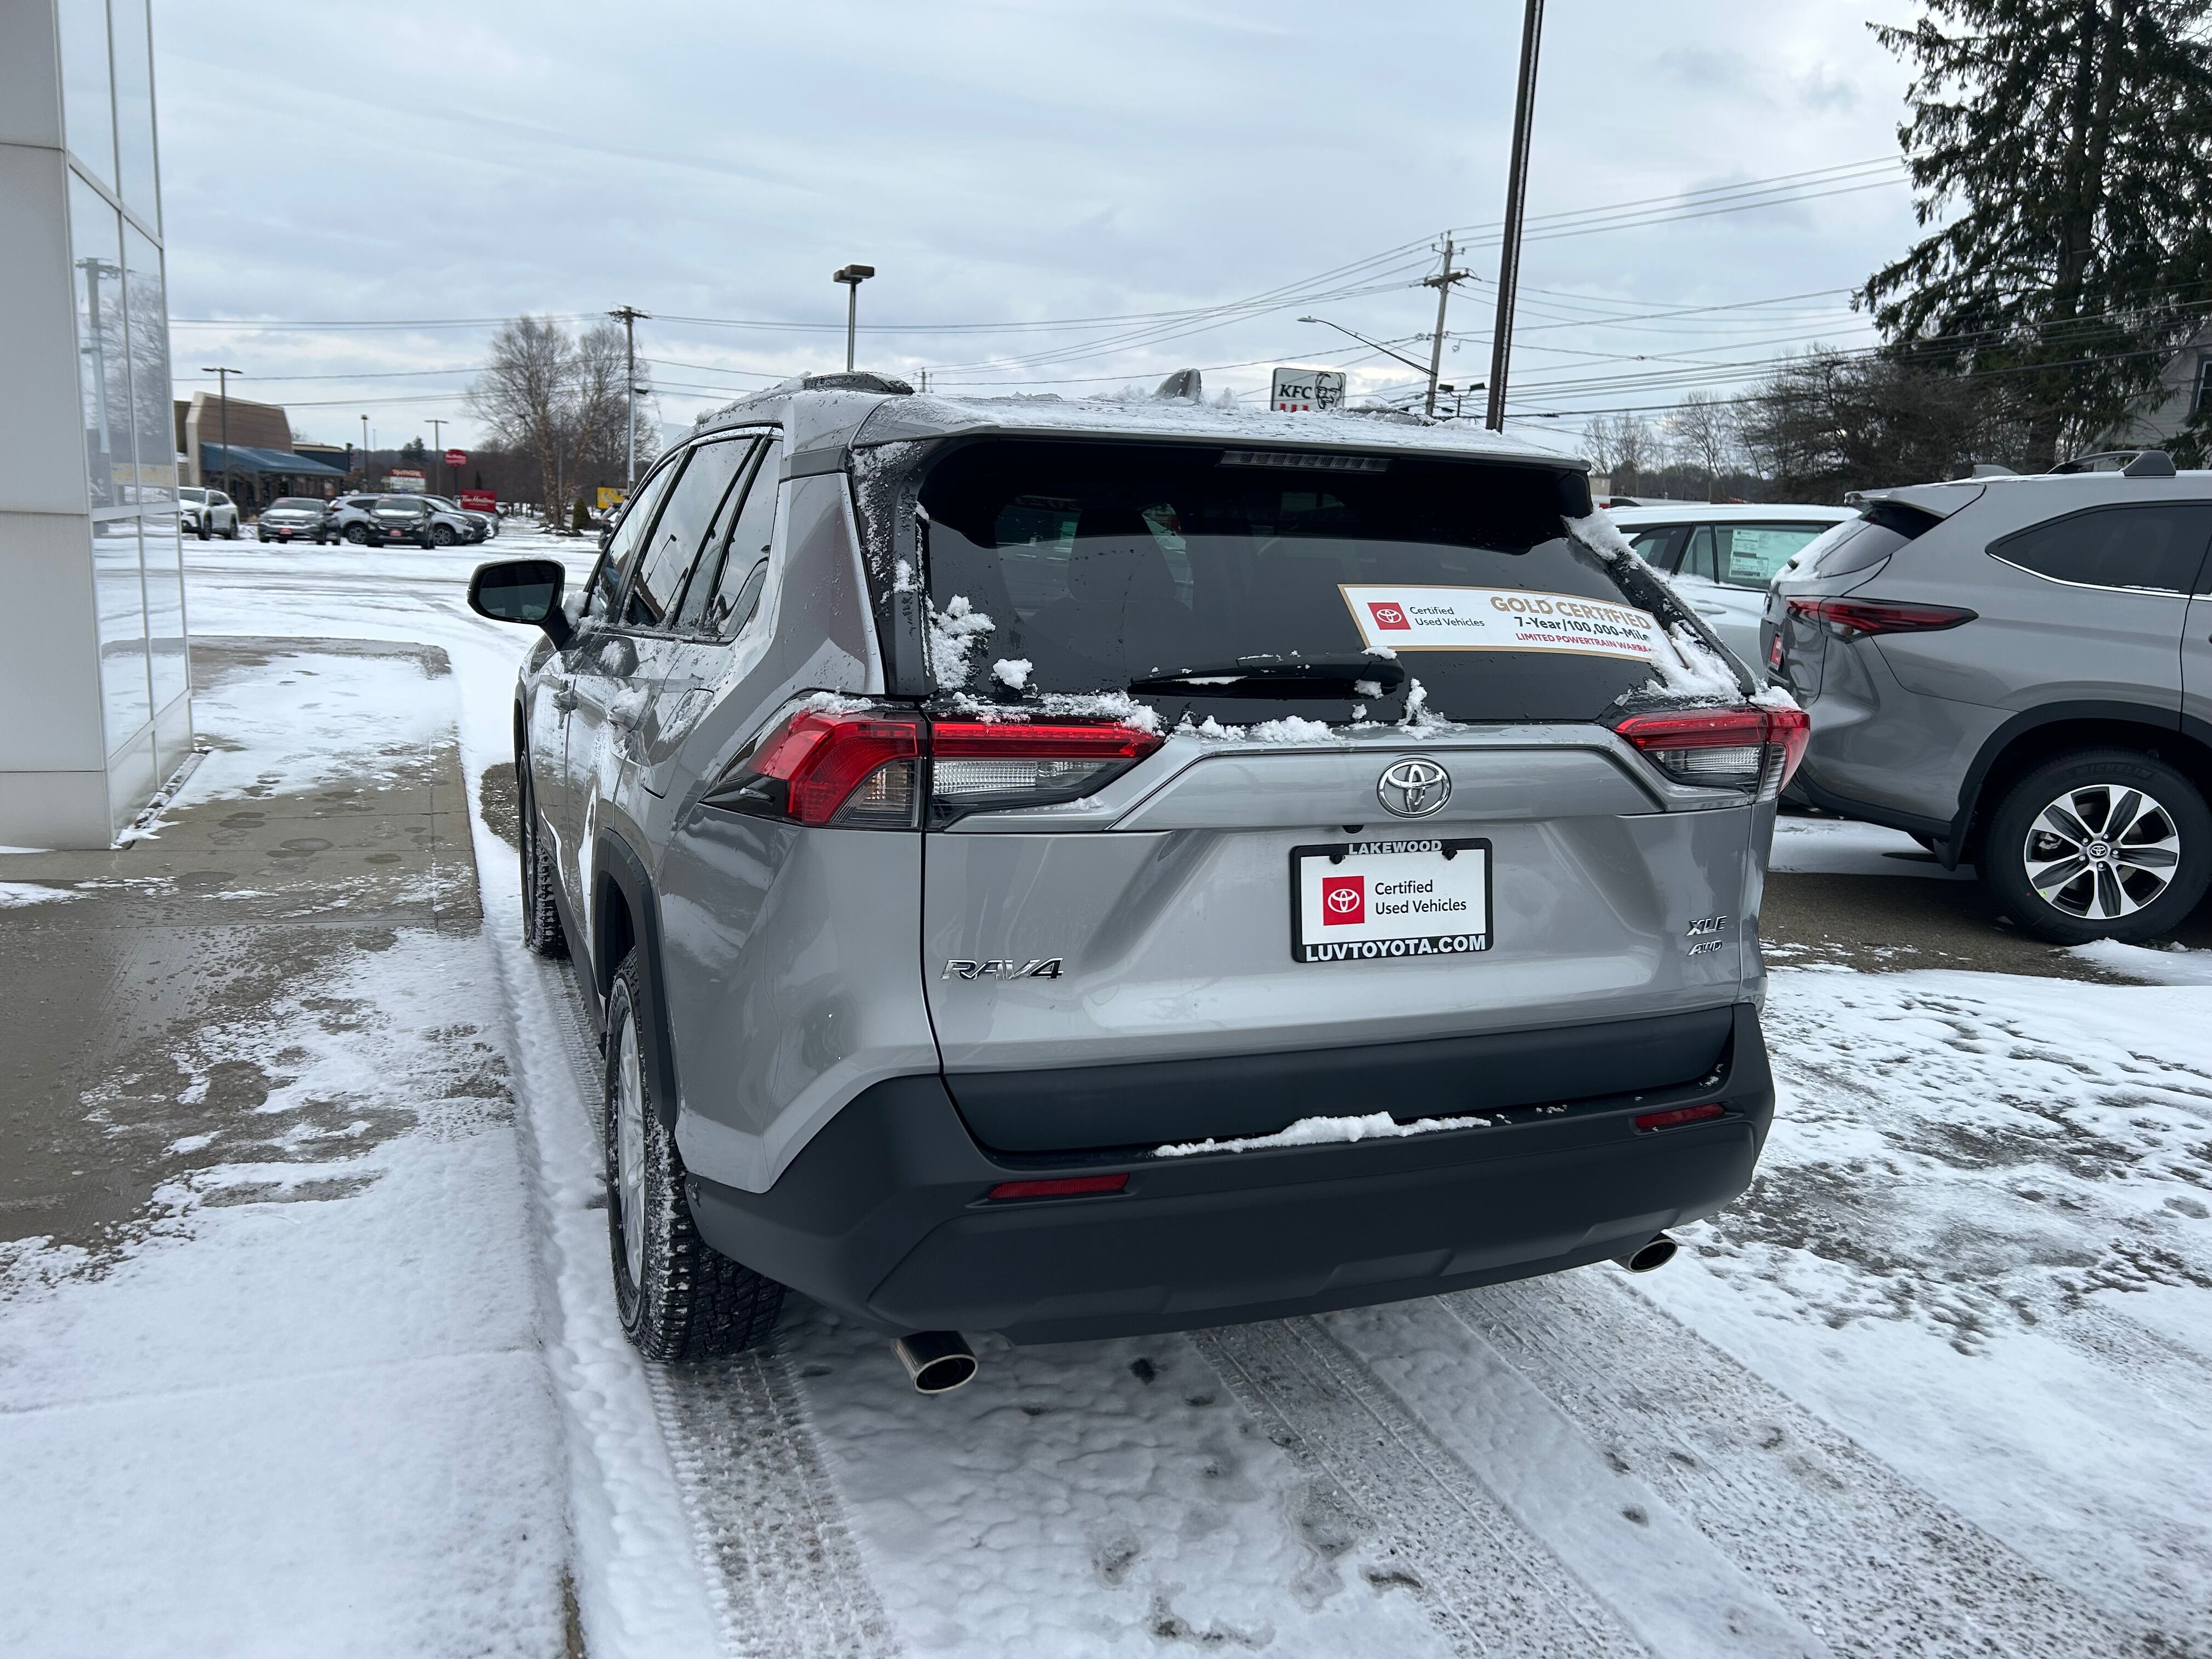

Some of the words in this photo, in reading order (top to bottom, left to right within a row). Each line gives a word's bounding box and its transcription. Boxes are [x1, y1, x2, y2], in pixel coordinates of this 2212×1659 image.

[1278, 383, 1312, 399] KFC
[1409, 606, 1455, 615] Certified
[1491, 597, 1553, 614] GOLD
[1556, 602, 1651, 629] CERTIFIED
[1414, 618, 1442, 626] Used
[1442, 618, 1485, 627] Vehicles
[1515, 633, 1555, 642] LIMITED
[1555, 635, 1617, 648] POWERTRAIN
[1616, 641, 1651, 652] WARRA
[1348, 840, 1442, 855] LAKEWOOD
[1375, 879, 1433, 895] Certified
[1375, 900, 1408, 915] Used
[1413, 899, 1466, 913] Vehicles
[1685, 915, 1727, 936] XLE
[1306, 935, 1486, 962] LUVTOYOTA.COM
[1687, 940, 1723, 956] AWD
[940, 957, 1064, 981] RAV4
